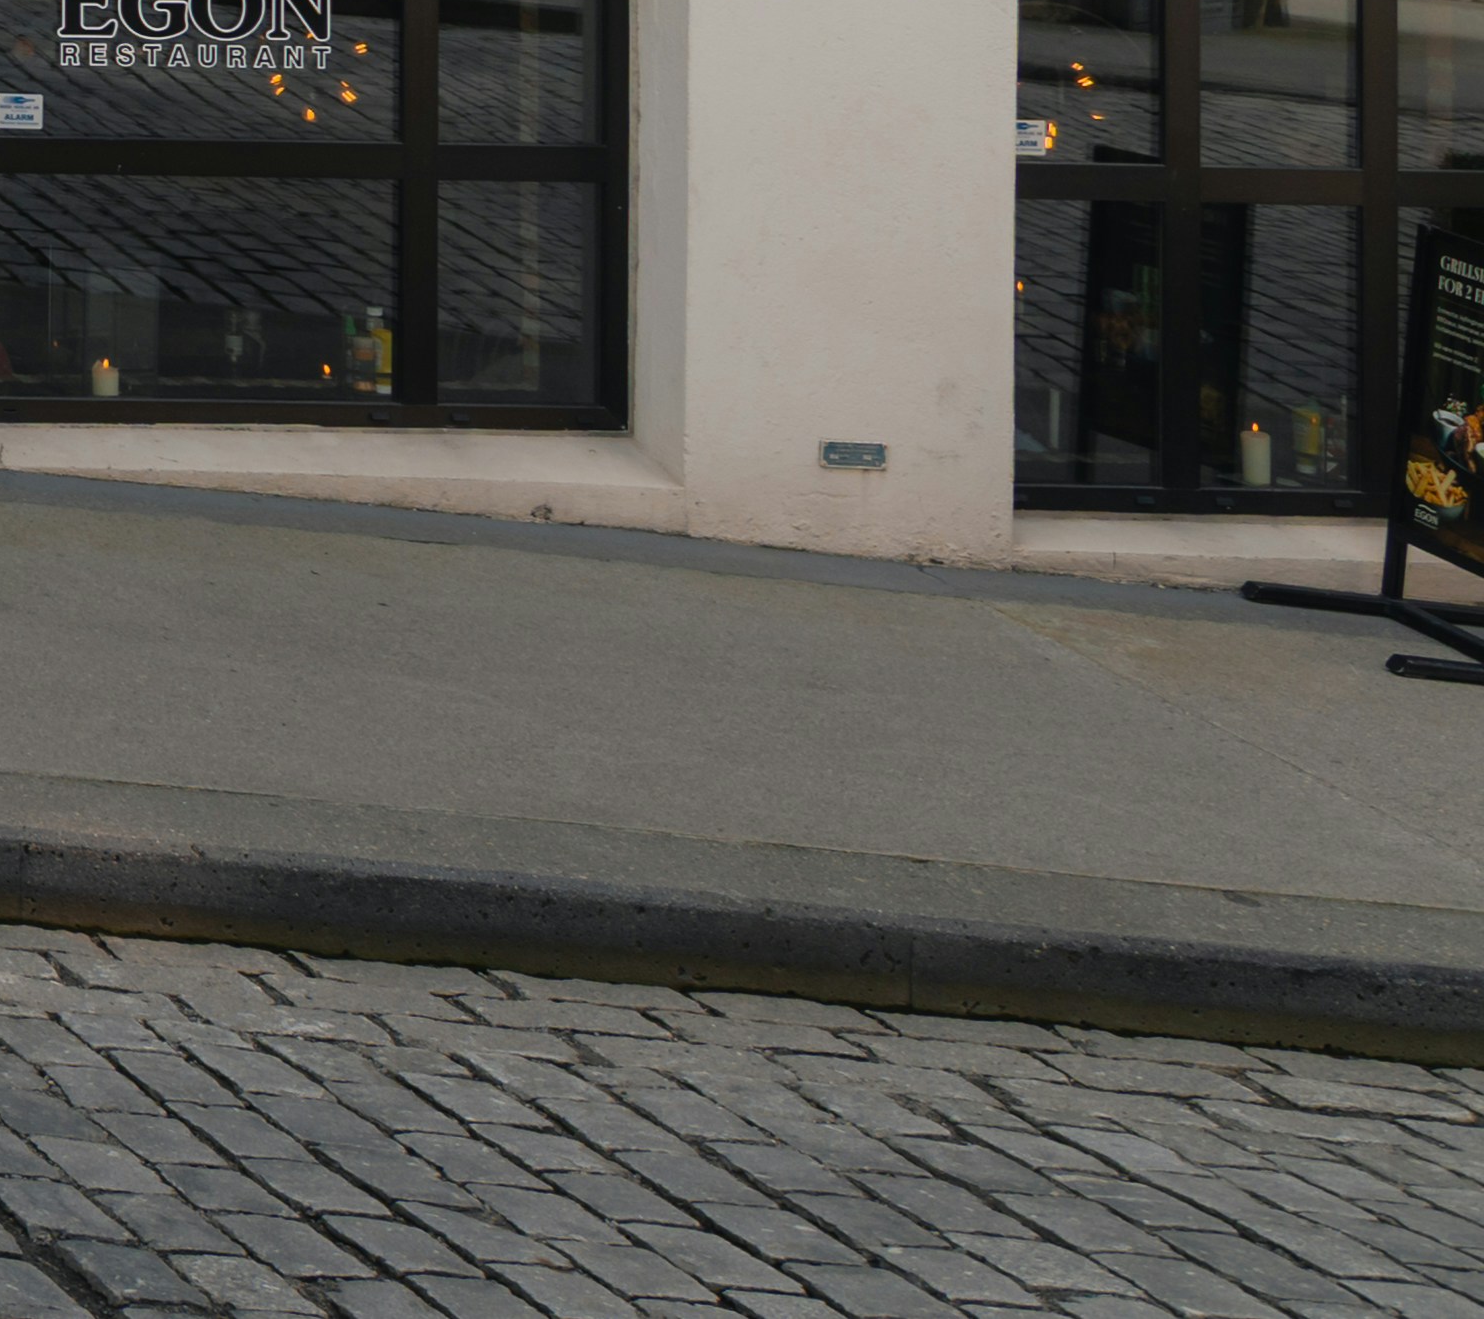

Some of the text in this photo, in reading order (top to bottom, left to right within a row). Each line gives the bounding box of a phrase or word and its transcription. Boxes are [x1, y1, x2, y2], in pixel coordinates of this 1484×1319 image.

[59, 42, 332, 70] RESTAURANT
[4, 113, 35, 121] ALARM
[1440, 255, 1484, 283] GRILLS
[1438, 274, 1484, 305] FOR 2 E
[1414, 508, 1439, 525] EGON
